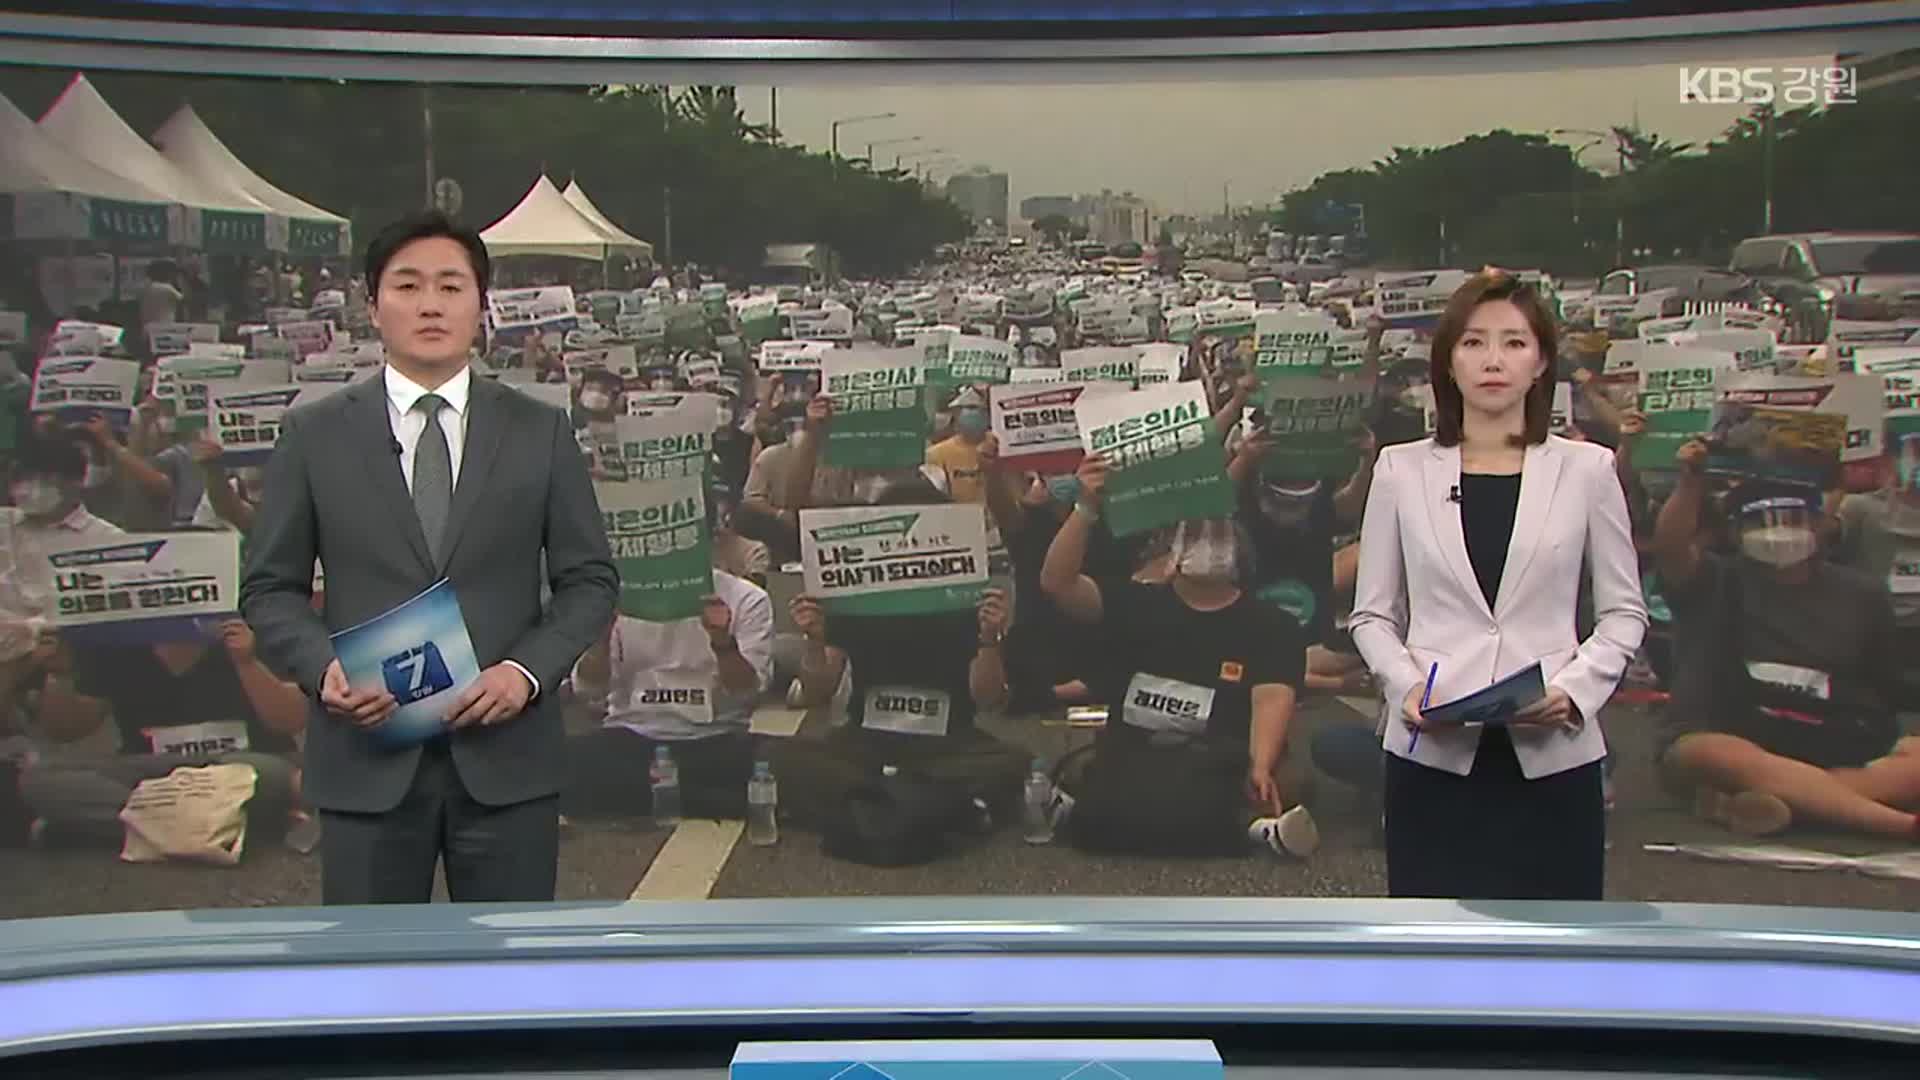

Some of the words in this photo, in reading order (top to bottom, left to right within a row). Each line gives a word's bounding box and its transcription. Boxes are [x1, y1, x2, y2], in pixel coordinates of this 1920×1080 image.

[829, 366, 916, 394] 젊은의사
[1091, 400, 1198, 449] 젊은의사
[818, 545, 865, 566] 나는
[56, 572, 104, 592] 나는
[821, 564, 885, 588] 의사가
[396, 652, 425, 691] 7
